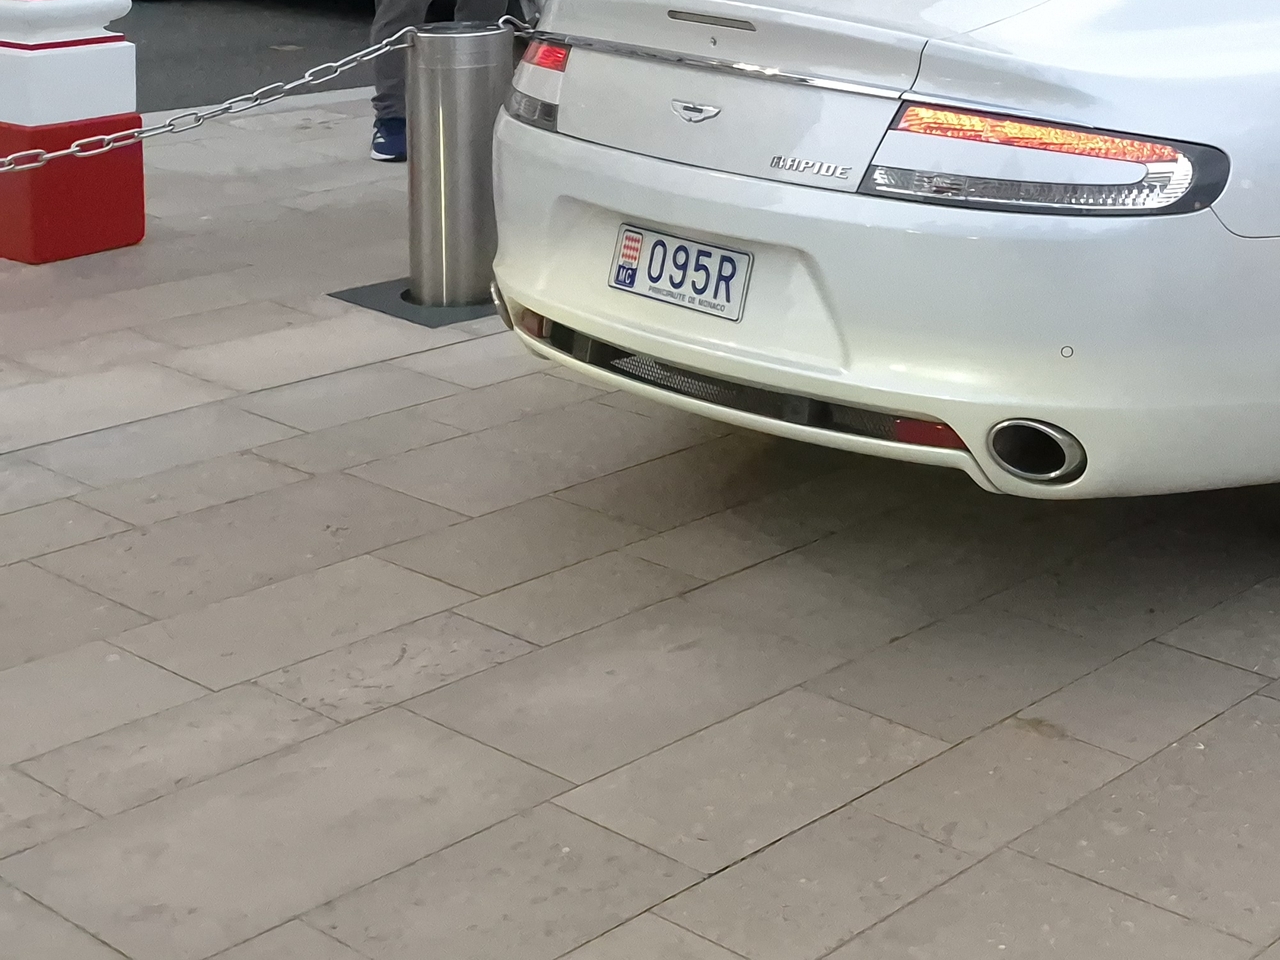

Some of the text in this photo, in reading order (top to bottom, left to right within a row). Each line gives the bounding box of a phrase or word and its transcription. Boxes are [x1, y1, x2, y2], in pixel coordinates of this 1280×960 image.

[770, 154, 853, 180] RAPIDE
[618, 266, 633, 284] MC
[647, 239, 738, 304] 095R
[698, 298, 726, 313] MONACO
